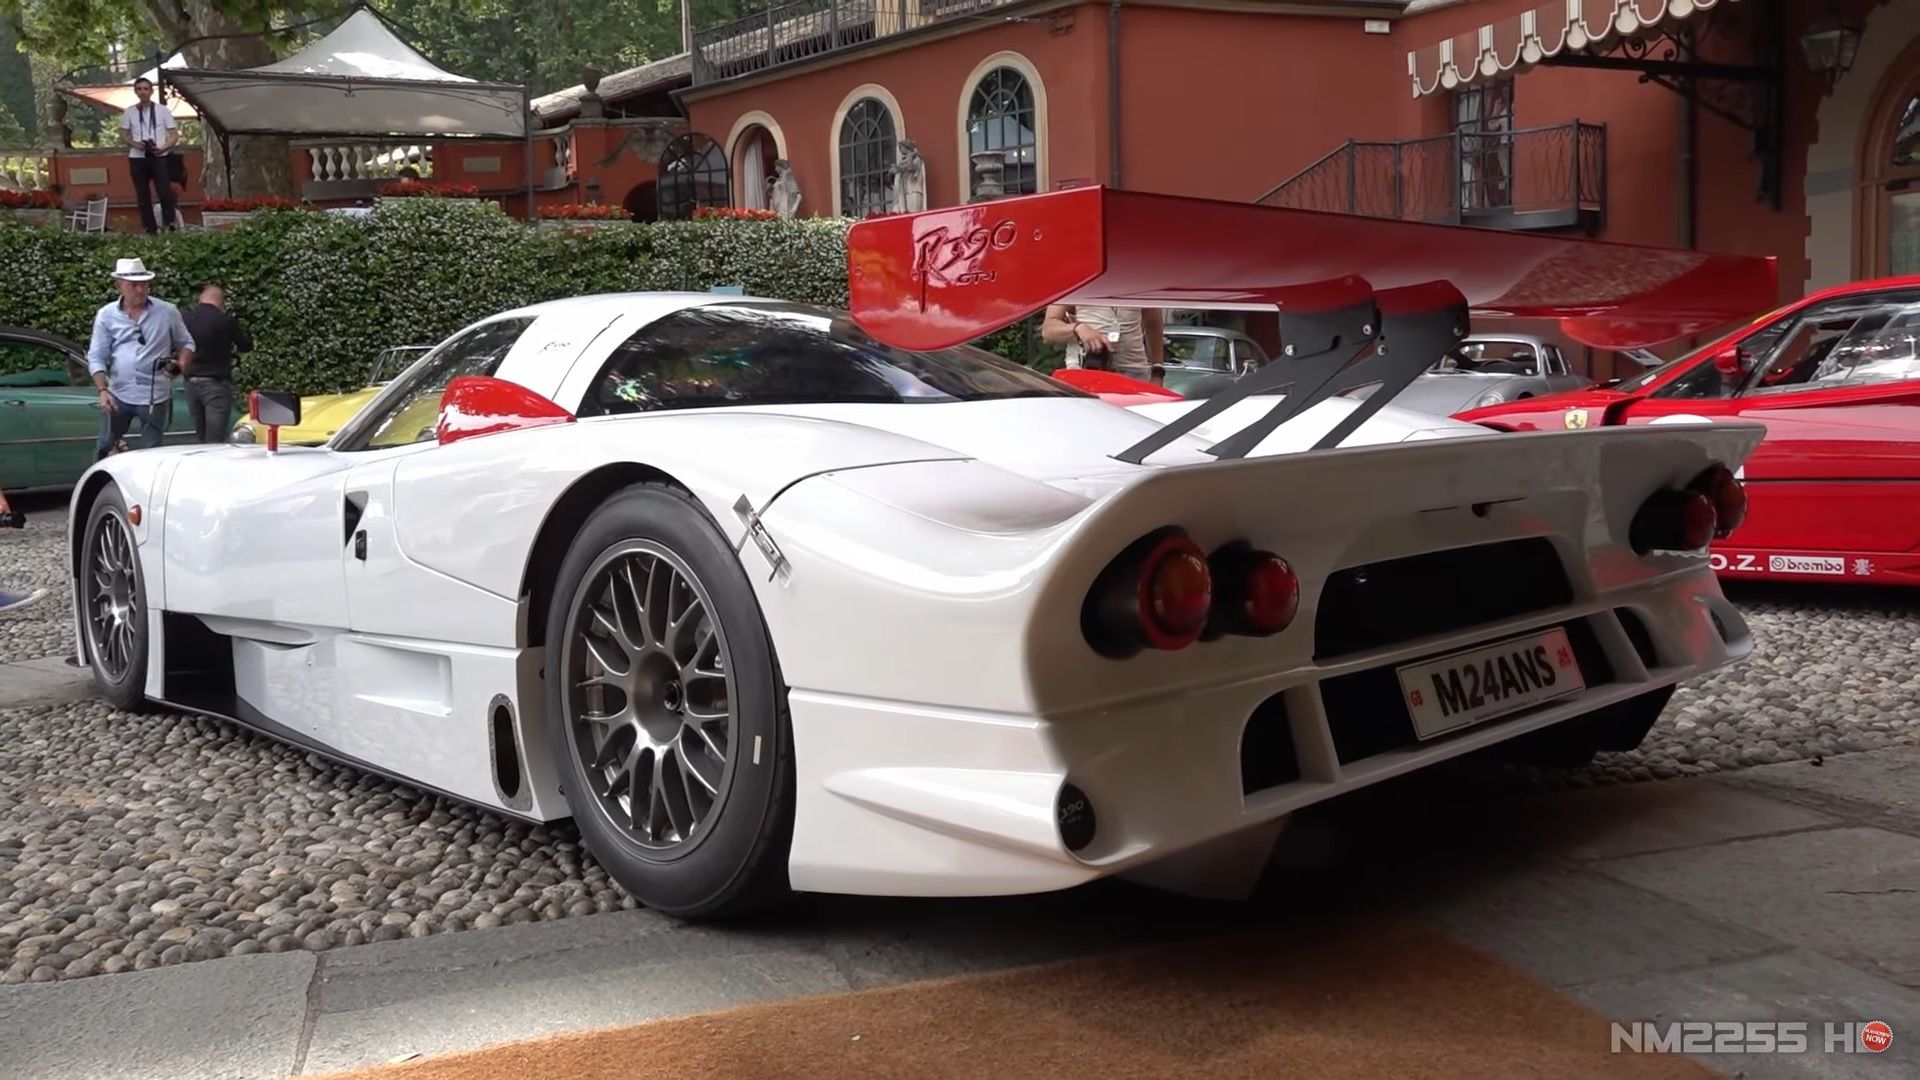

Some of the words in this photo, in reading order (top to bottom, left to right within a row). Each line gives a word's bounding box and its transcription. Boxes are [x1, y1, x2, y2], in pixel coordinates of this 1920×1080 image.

[916, 219, 1018, 314] R390
[1787, 558, 1844, 572] brembo
[1431, 646, 1556, 717] M24ANS
[1059, 800, 1084, 825] 390
